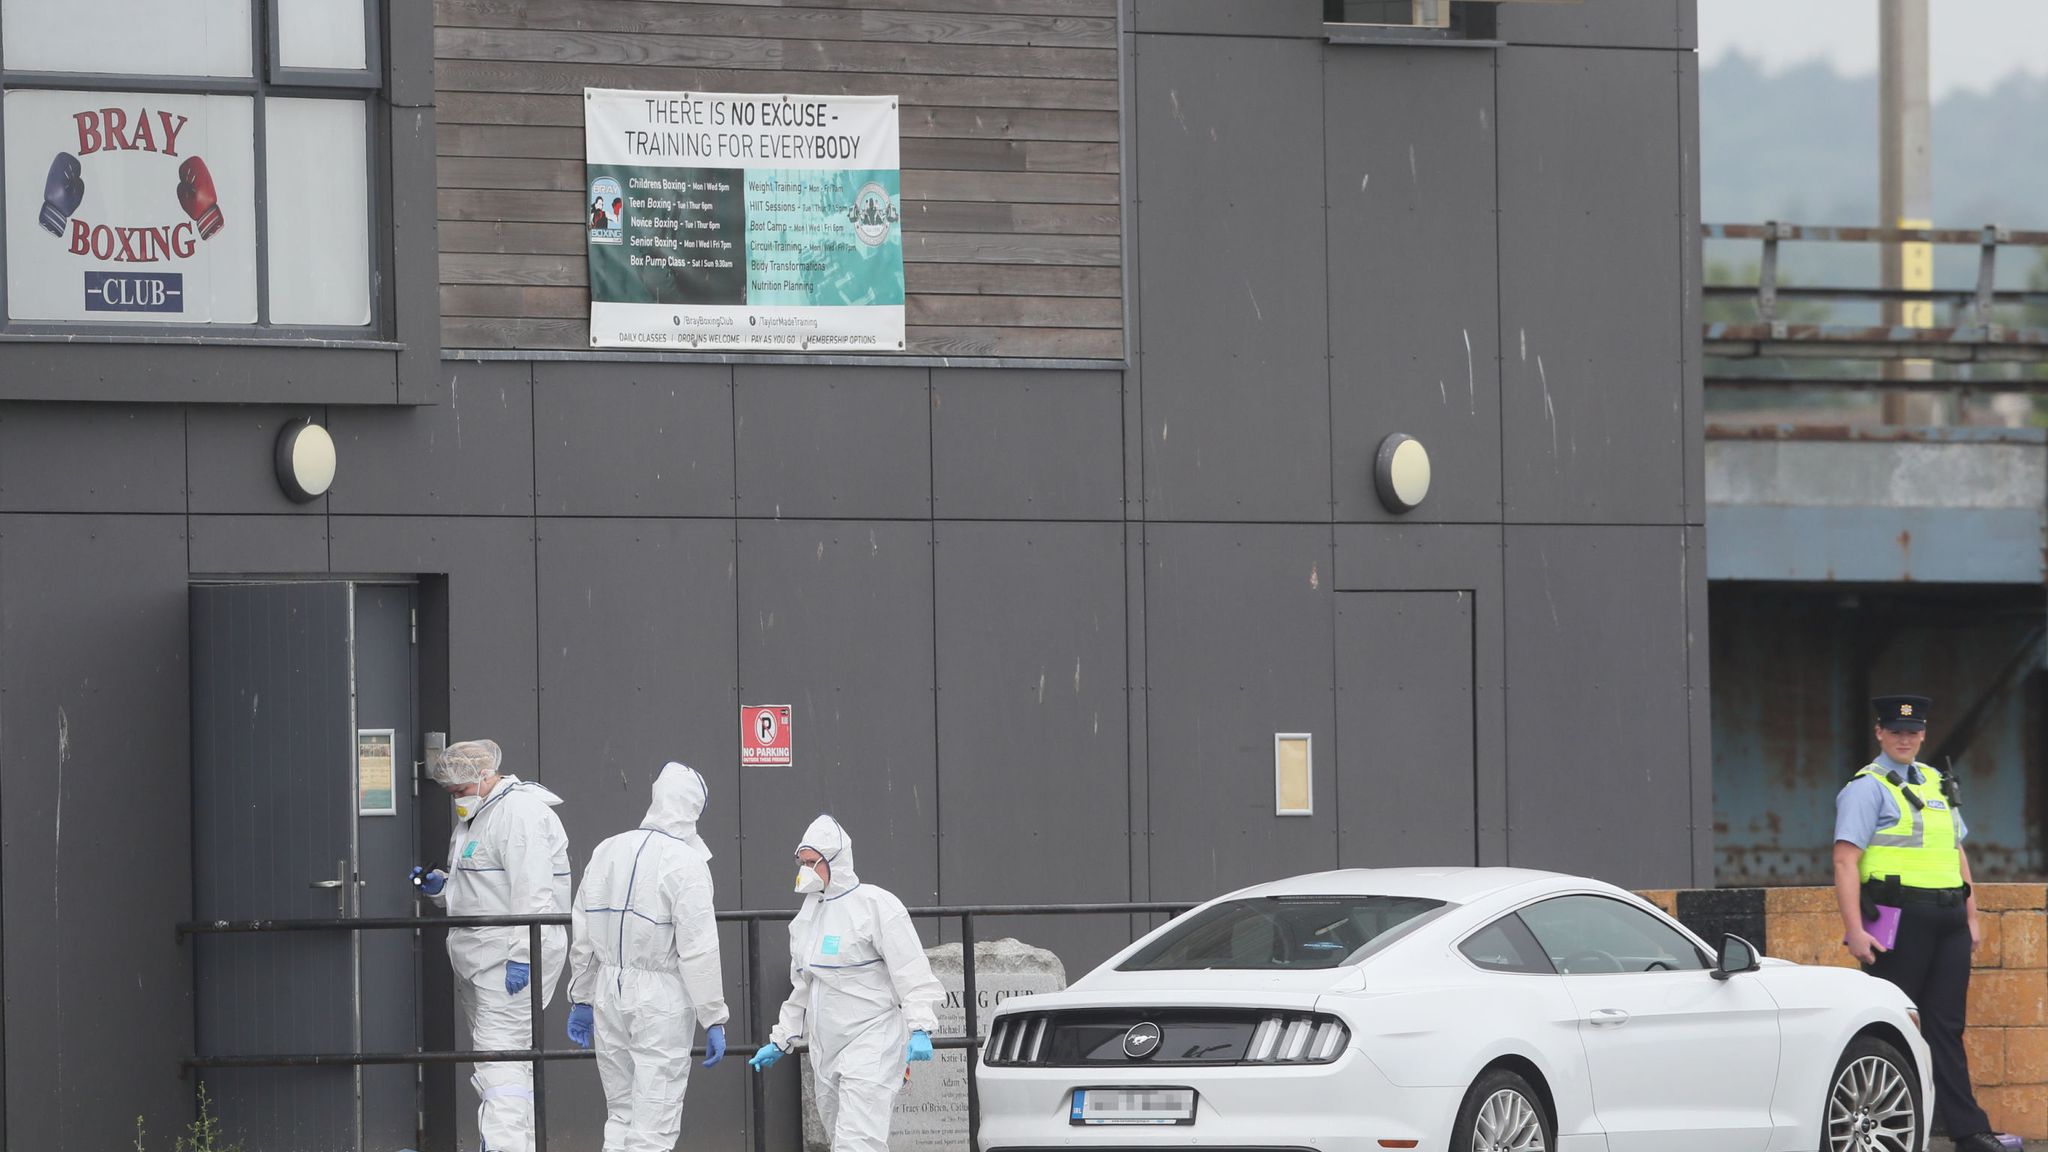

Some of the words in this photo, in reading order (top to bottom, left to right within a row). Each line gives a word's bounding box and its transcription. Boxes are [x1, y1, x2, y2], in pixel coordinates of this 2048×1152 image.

[645, 99, 703, 125] THERE
[710, 101, 725, 126] IS
[731, 102, 755, 127] NO
[762, 103, 827, 127] EXCUSE
[73, 107, 188, 157] BRAY
[625, 131, 712, 158] TRAINING
[718, 133, 753, 158] FOR
[760, 135, 860, 159] EVERYBODY
[593, 185, 618, 194] BRAY
[629, 178, 661, 189] Childrens
[663, 179, 686, 192] Boxing
[692, 182, 703, 190] Mon
[707, 183, 718, 191] Wed
[749, 181, 773, 194] Weight
[775, 181, 802, 194] Training
[629, 197, 645, 208] Teen
[648, 198, 671, 211] Boxing
[677, 201, 687, 209] Tue
[766, 201, 795, 212] Sessions
[631, 216, 652, 228] Novice
[654, 217, 678, 230] Boxing
[685, 221, 694, 229] Tue
[697, 221, 708, 229] Thur
[750, 221, 765, 231] Boot
[767, 221, 787, 232] Camp
[592, 229, 622, 238] BOXING
[68, 219, 196, 263] BOXING
[630, 236, 653, 247] Senior
[654, 237, 677, 250] Boxing
[684, 240, 695, 248] Mon
[699, 240, 710, 248] Wed
[751, 240, 773, 251] Circuit
[774, 241, 802, 254] Training
[630, 255, 643, 266] Box
[645, 255, 667, 269] Pump
[668, 256, 686, 267] Class
[692, 259, 700, 267] Sat
[704, 260, 714, 268] Sun
[751, 260, 768, 272] Body
[770, 260, 825, 272] Transformations
[751, 280, 782, 291] Nutrition
[784, 281, 813, 293] Planning
[619, 332, 637, 342] DAILY
[638, 333, 667, 342] CLASSES
[709, 334, 740, 343] WELCOME
[751, 336, 762, 344] PAY
[763, 336, 772, 344] AS
[772, 336, 786, 344] YOU
[787, 336, 796, 344] GO
[806, 336, 848, 344] MEMBERSHIP
[850, 336, 876, 344] OPTIONS
[743, 747, 755, 757] NO
[757, 747, 789, 757] PARKING
